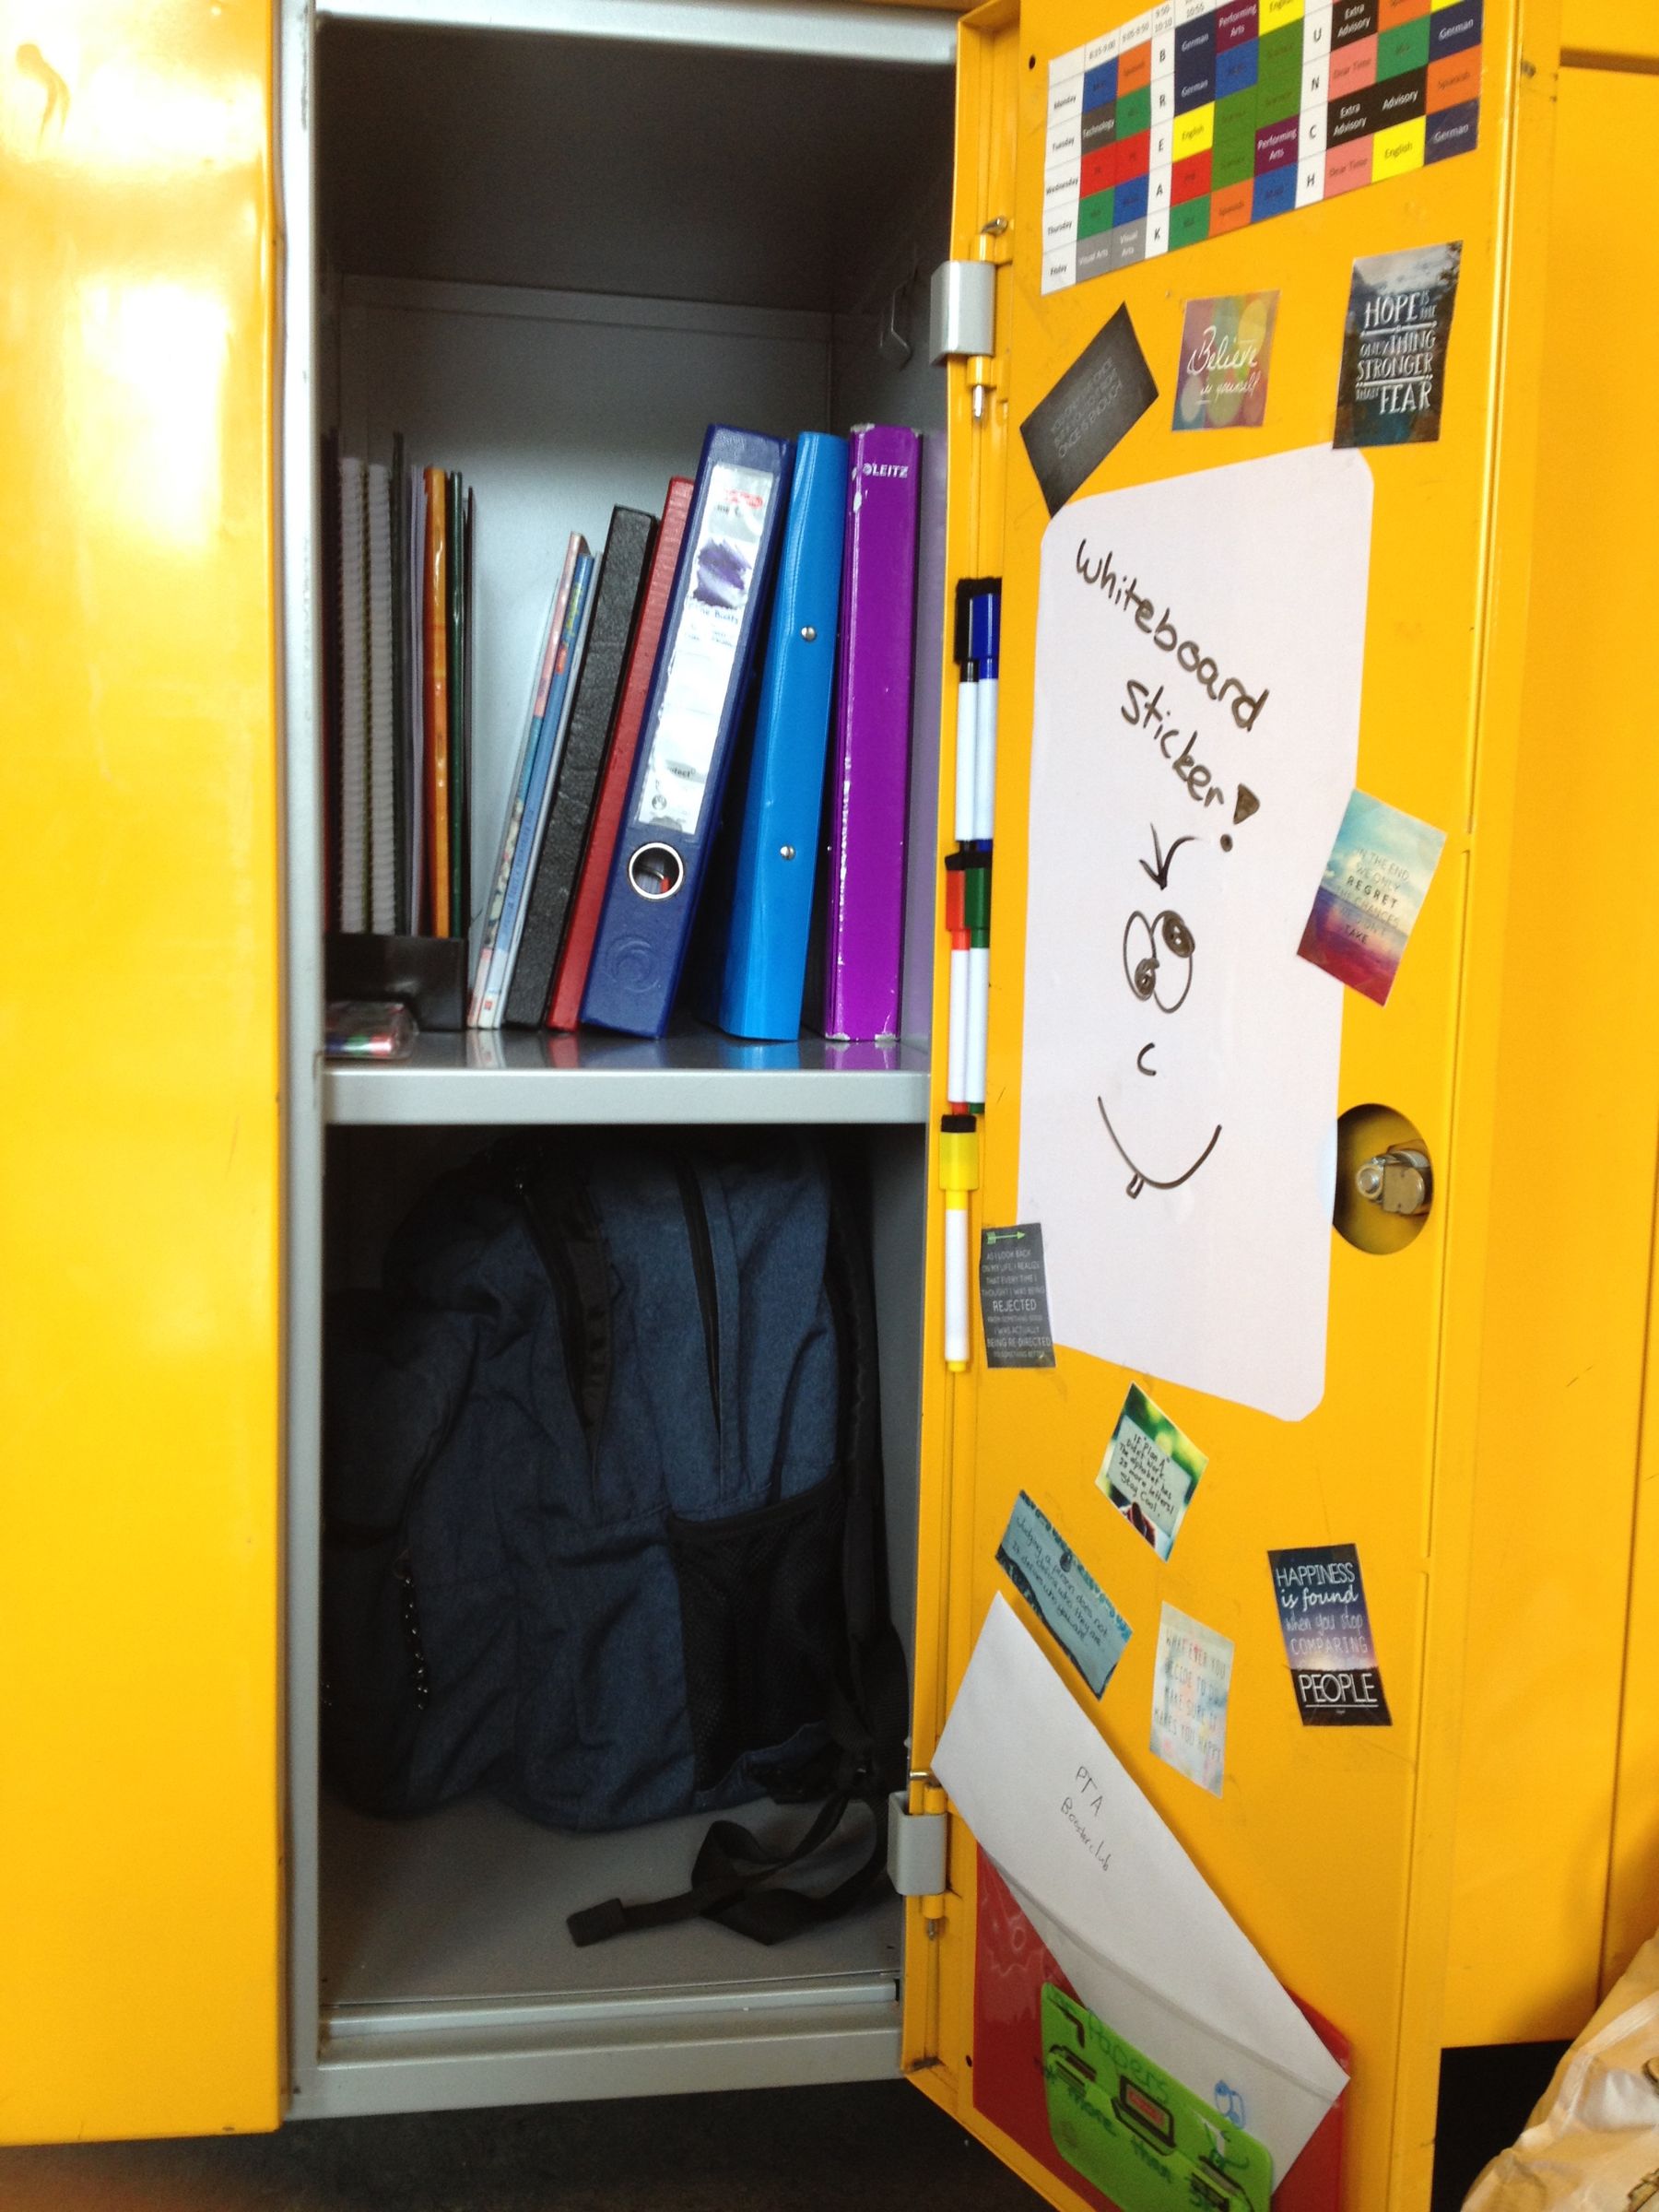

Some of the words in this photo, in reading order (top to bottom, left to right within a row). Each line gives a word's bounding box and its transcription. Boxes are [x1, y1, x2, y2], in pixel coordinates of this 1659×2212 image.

[1218, 4, 1257, 28] Performing
[1345, 4, 1365, 20] Extra
[1230, 24, 1245, 38] Arts
[1337, 17, 1371, 38] Advisory
[1438, 18, 1475, 41] German
[1181, 33, 1209, 53] German
[1181, 79, 1208, 98] German
[1339, 102, 1360, 119] Extra
[1382, 89, 1418, 111] Advisory
[1083, 119, 1115, 138] Technology
[1333, 117, 1367, 136] Advisory
[1433, 124, 1469, 144] German
[1257, 127, 1297, 150] Performing
[1269, 147, 1284, 161] Arts
[1384, 141, 1414, 159] English
[1364, 291, 1420, 328] HOPE
[1186, 325, 1258, 376] Believe
[1388, 330, 1437, 355] THING
[1357, 352, 1434, 382] STRONGER
[1379, 382, 1433, 415] FEAR
[872, 464, 909, 478] LEITZ
[1347, 876, 1399, 910] REGRET
[993, 1299, 1038, 1313] REJECTED
[1120, 1471, 1139, 1499] Stay
[1129, 1467, 1147, 1488] more
[1276, 1562, 1356, 1587] HAPPINESS
[1280, 1588, 1299, 1609] is
[1301, 1584, 1359, 1612] found
[1314, 1614, 1335, 1636] you
[1290, 1636, 1369, 1655] COMPARING
[1298, 1673, 1378, 1703] PEOPLE
